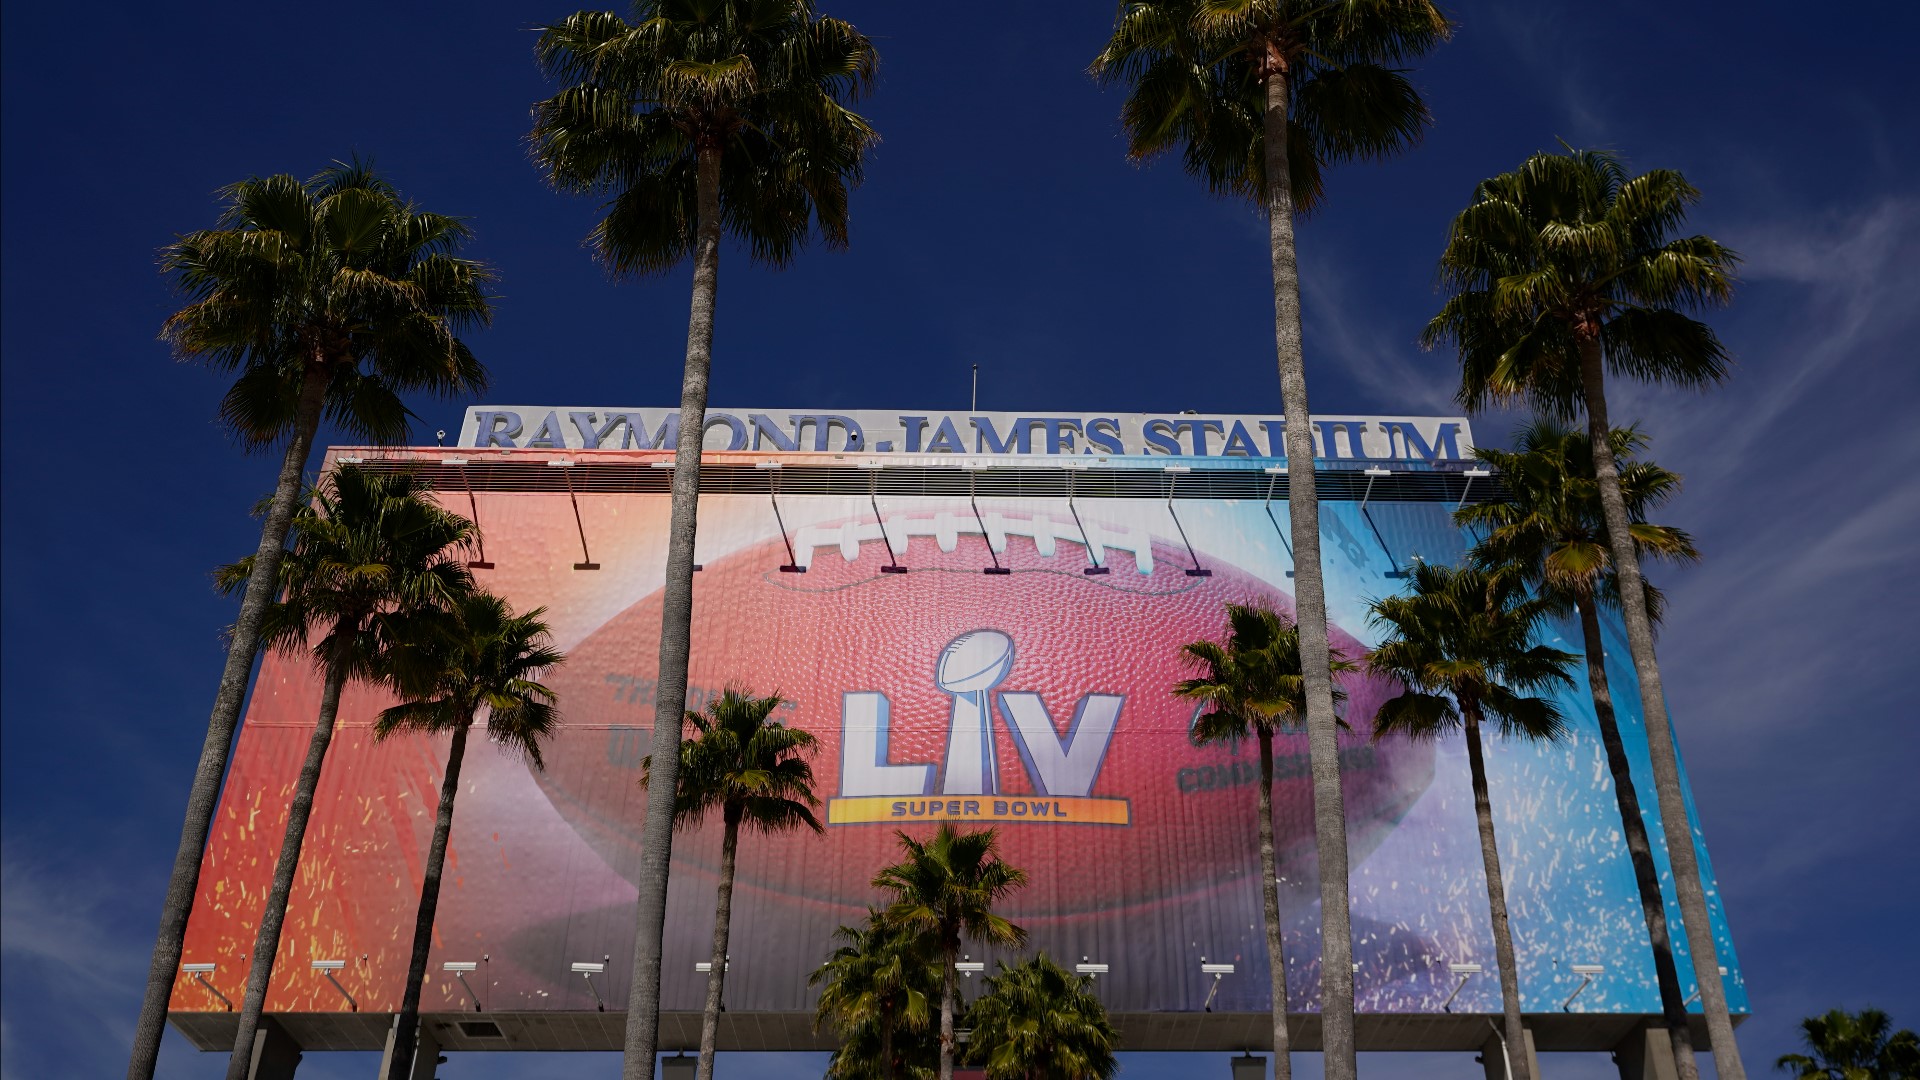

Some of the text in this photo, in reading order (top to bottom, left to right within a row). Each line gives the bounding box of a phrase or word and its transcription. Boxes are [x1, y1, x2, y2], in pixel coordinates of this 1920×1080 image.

[474, 410, 865, 453] RAYMOND
[876, 415, 1124, 455] JAMES
[839, 627, 1124, 798] LIV
[891, 800, 1067, 817] SUPER BOWL
